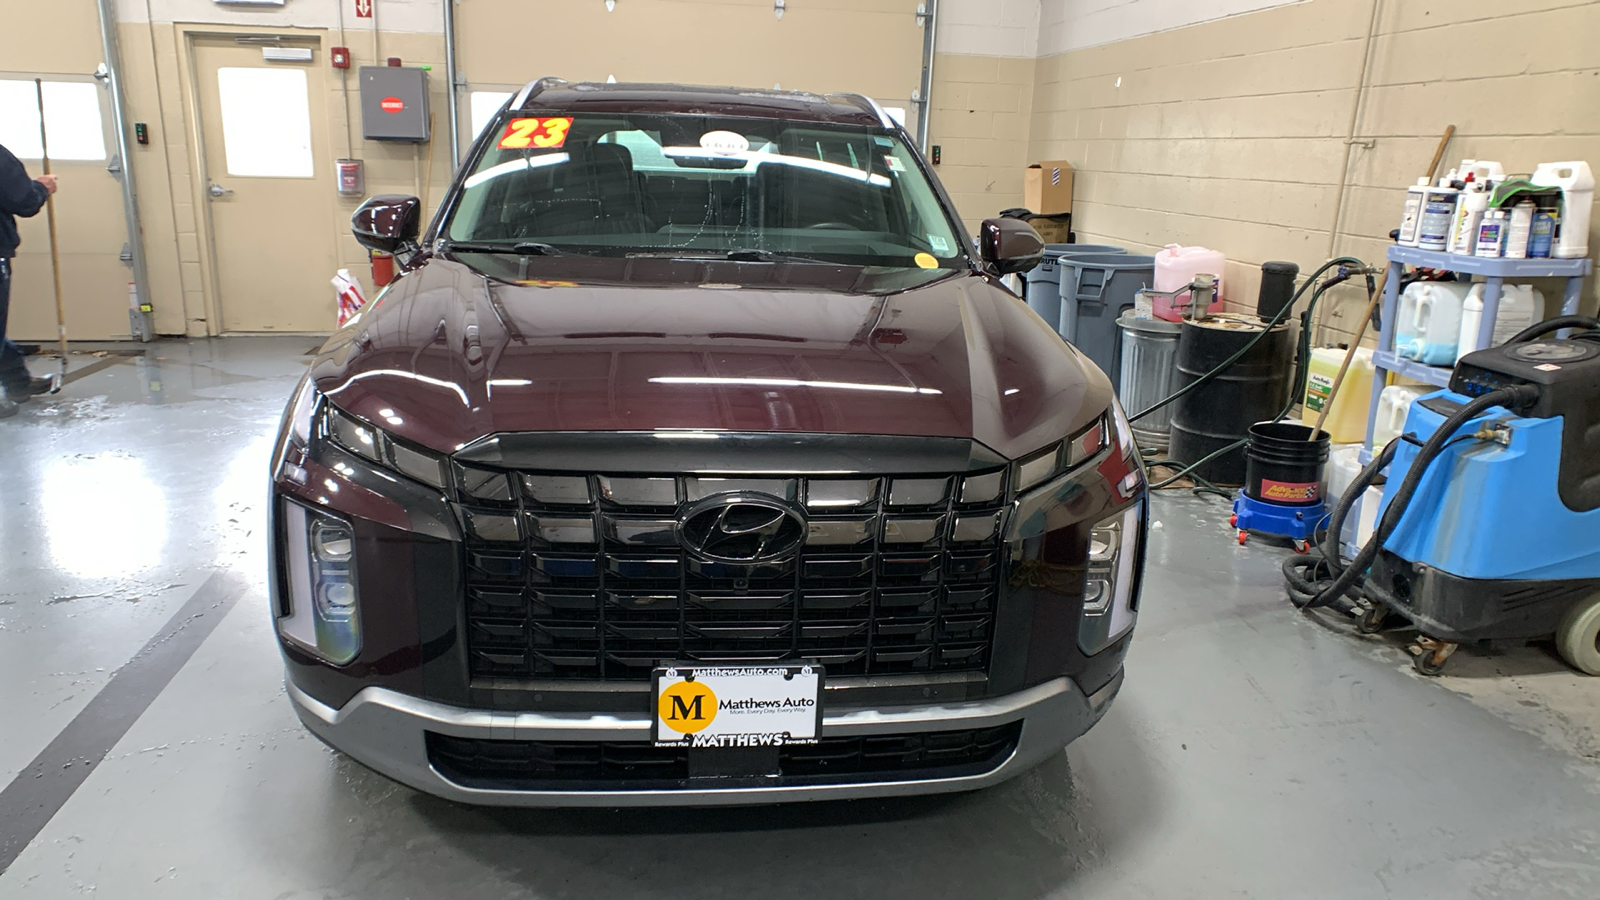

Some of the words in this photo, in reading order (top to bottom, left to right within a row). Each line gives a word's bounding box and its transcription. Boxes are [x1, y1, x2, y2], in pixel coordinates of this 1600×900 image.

[501, 117, 569, 148] 23
[692, 666, 788, 677] MatthewsAuto.com
[667, 695, 706, 720] M
[719, 697, 780, 710] Matthews
[782, 697, 815, 708] Auto
[692, 734, 783, 747] MATTHEWS
